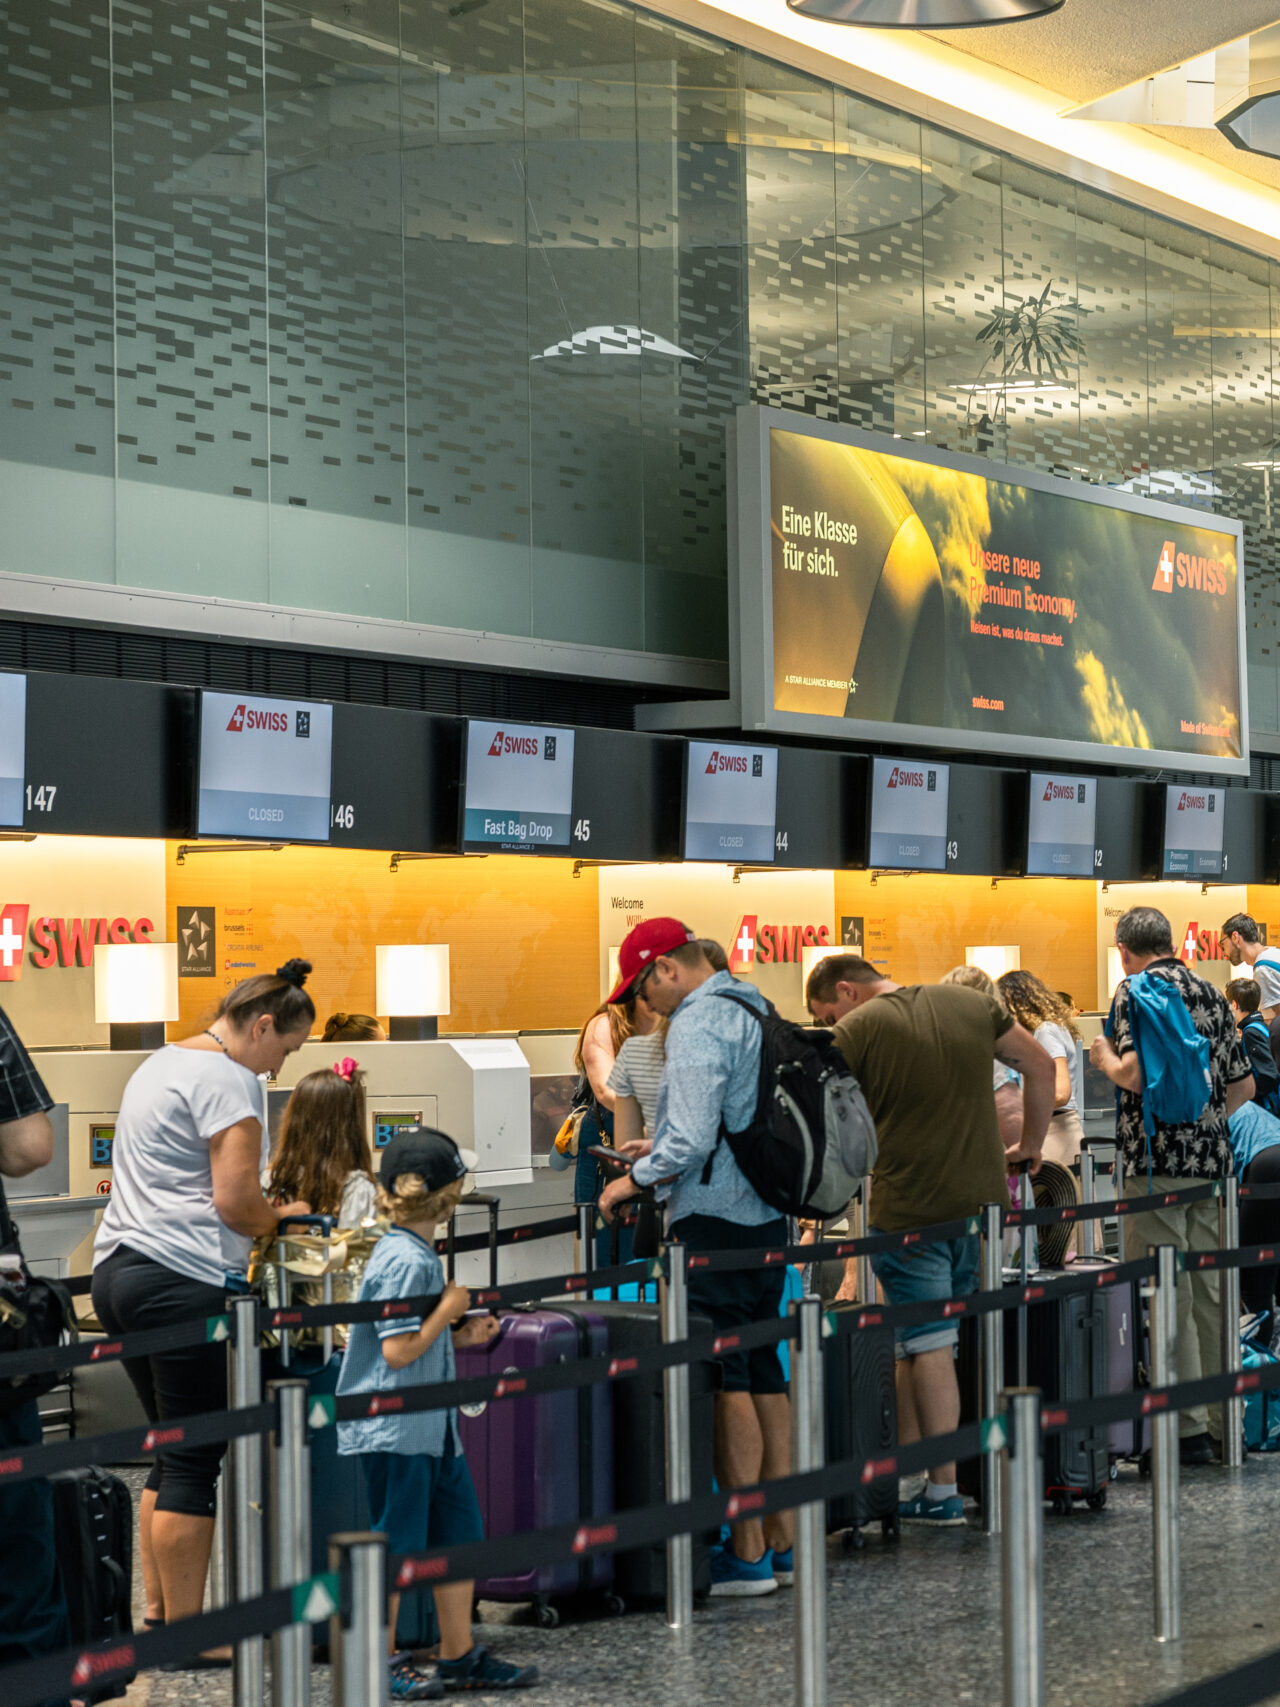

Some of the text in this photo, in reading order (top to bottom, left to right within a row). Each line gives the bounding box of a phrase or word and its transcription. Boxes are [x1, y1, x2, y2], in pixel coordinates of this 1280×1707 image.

[782, 505, 858, 545] Eine Klasse
[783, 541, 839, 577] für sich.
[969, 543, 1041, 580] Unsere neue
[1176, 551, 1227, 596] SWISS
[970, 576, 1078, 624] Premium Economy.
[970, 619, 991, 636] Reisen
[1002, 627, 1014, 639] was
[1015, 627, 1023, 640] du
[1024, 628, 1040, 643] draus
[785, 675, 848, 690] A STAR ALLIANCE MEMBER
[972, 695, 1005, 711] swiss.com
[247, 710, 288, 732] SWISS
[1181, 720, 1195, 734] Made
[1196, 722, 1201, 735] of
[505, 736, 538, 756] SWISS
[719, 755, 748, 773] SWISS
[899, 771, 923, 788] SWISS
[26, 785, 57, 811] 147
[1053, 785, 1075, 801] SWISS
[1186, 795, 1206, 810] SWISS
[248, 807, 284, 822] CLOSED
[484, 819, 553, 841] Fast Bag Drop
[719, 836, 743, 848] CLOSED
[776, 831, 788, 852] 44
[899, 845, 920, 856] CLOSED
[947, 840, 958, 860] 43
[611, 896, 644, 909] Welcome
